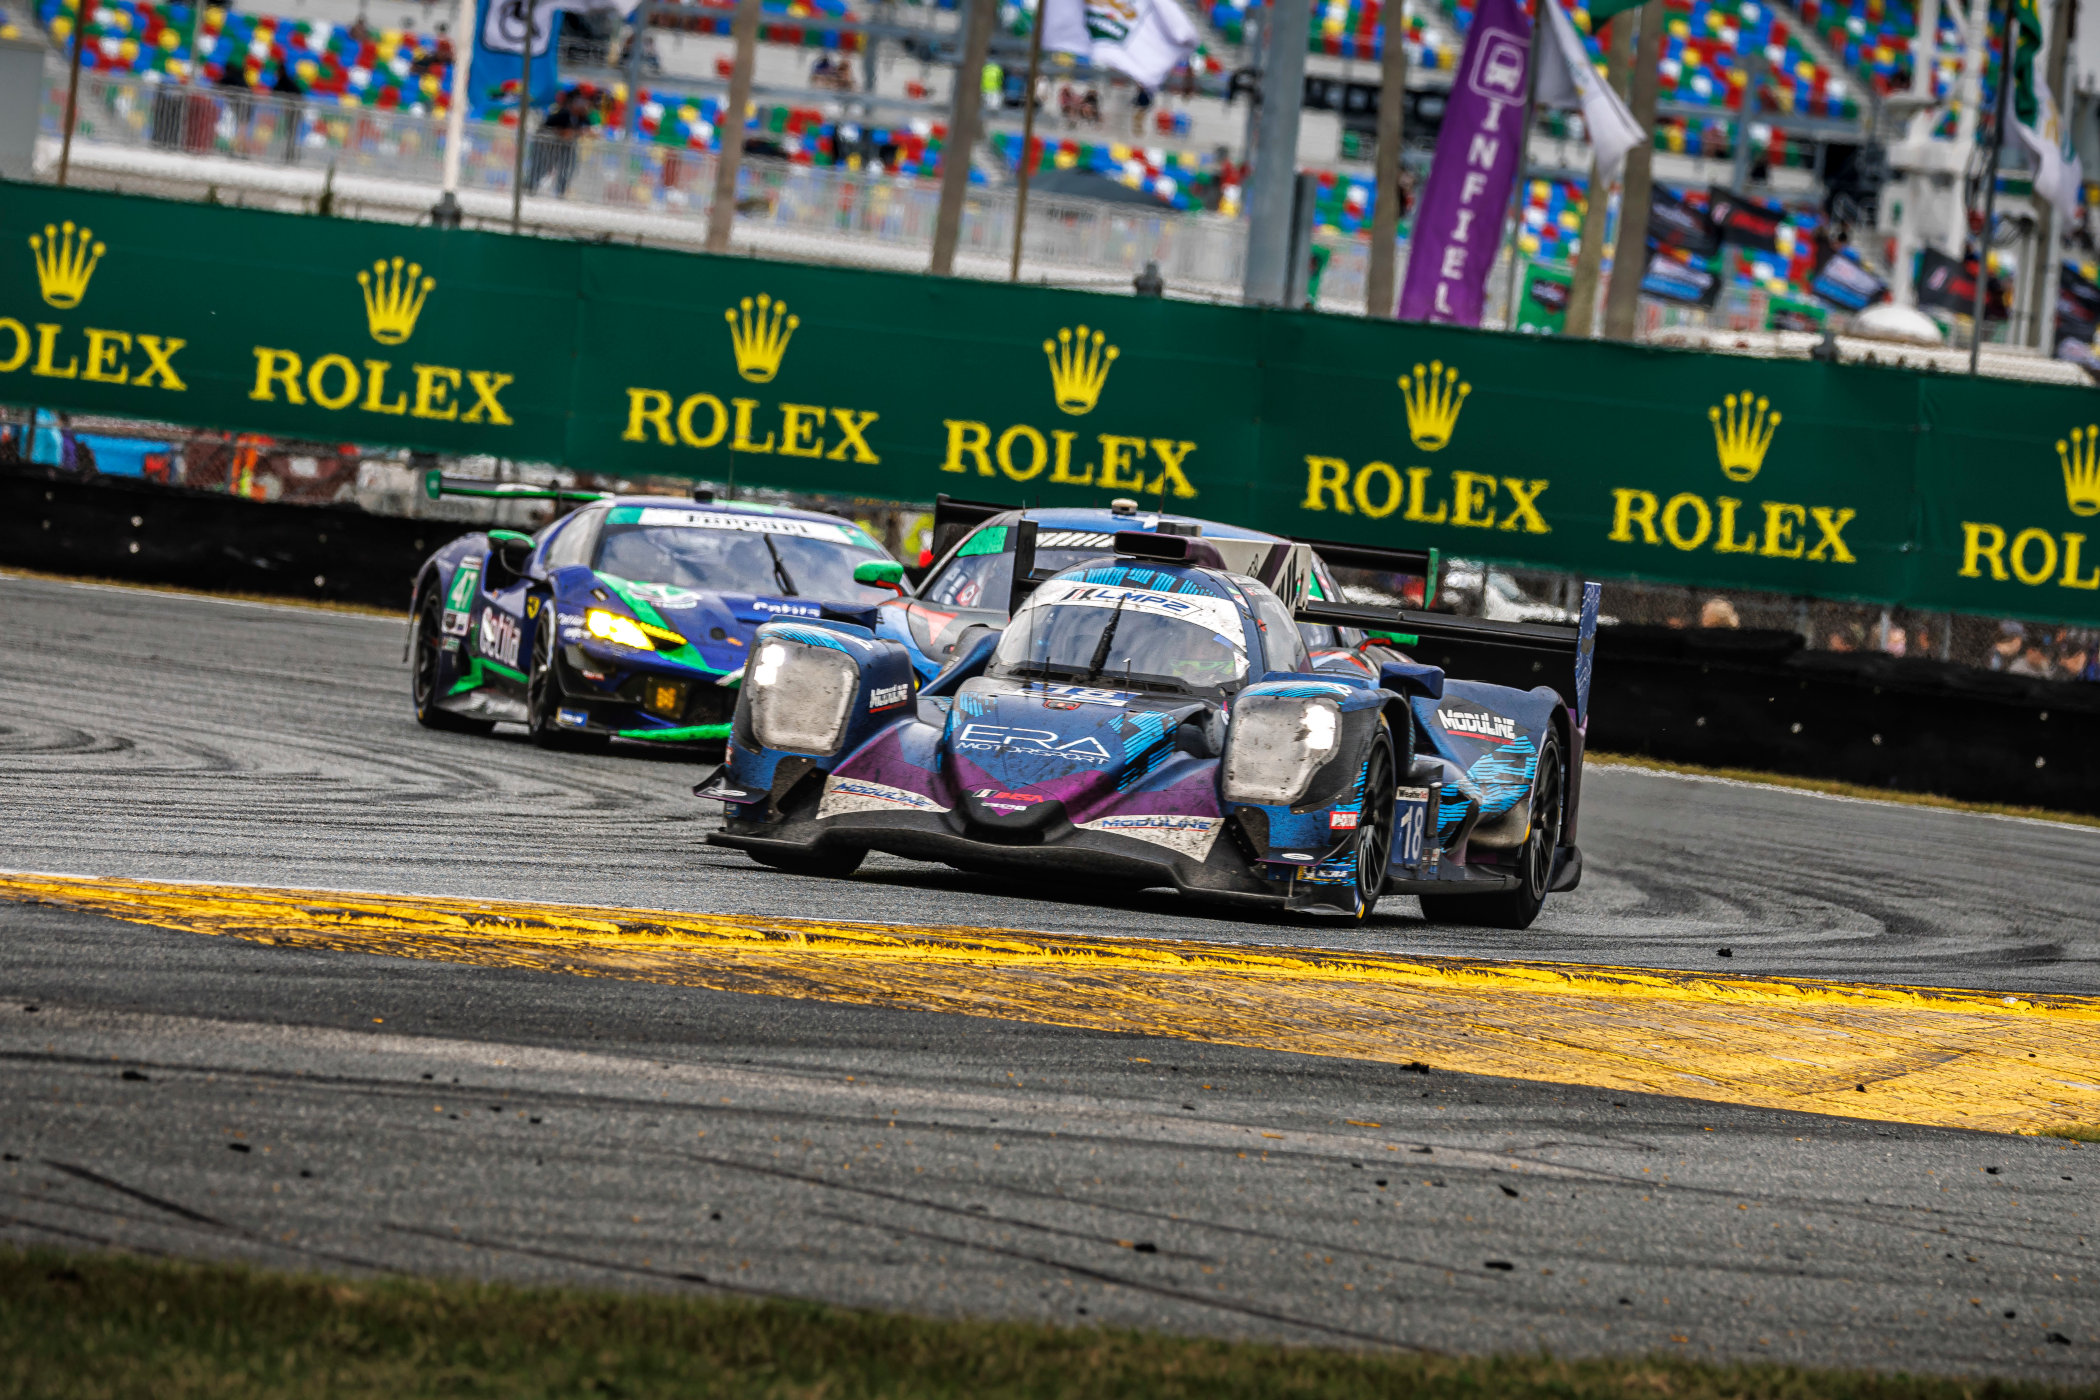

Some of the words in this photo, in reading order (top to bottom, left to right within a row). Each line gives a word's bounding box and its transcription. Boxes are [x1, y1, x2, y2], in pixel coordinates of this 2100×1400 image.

[1429, 99, 1505, 323] INFIEL
[0, 318, 186, 390] OLEX
[250, 347, 513, 426] ROLEX
[623, 387, 880, 465] ROLEX
[941, 419, 1197, 502] ROLEX
[1303, 455, 1551, 533] ROLEX
[1608, 488, 1856, 563] ROLEX
[1959, 522, 2100, 590] ROL
[1095, 590, 1190, 612] LMP2
[955, 741, 1110, 764] MOTORSPORT
[959, 723, 1111, 758] ERA
[1437, 709, 1516, 739] MODULINE
[1102, 818, 1211, 830] MODULINE
[1400, 805, 1424, 860] 18
